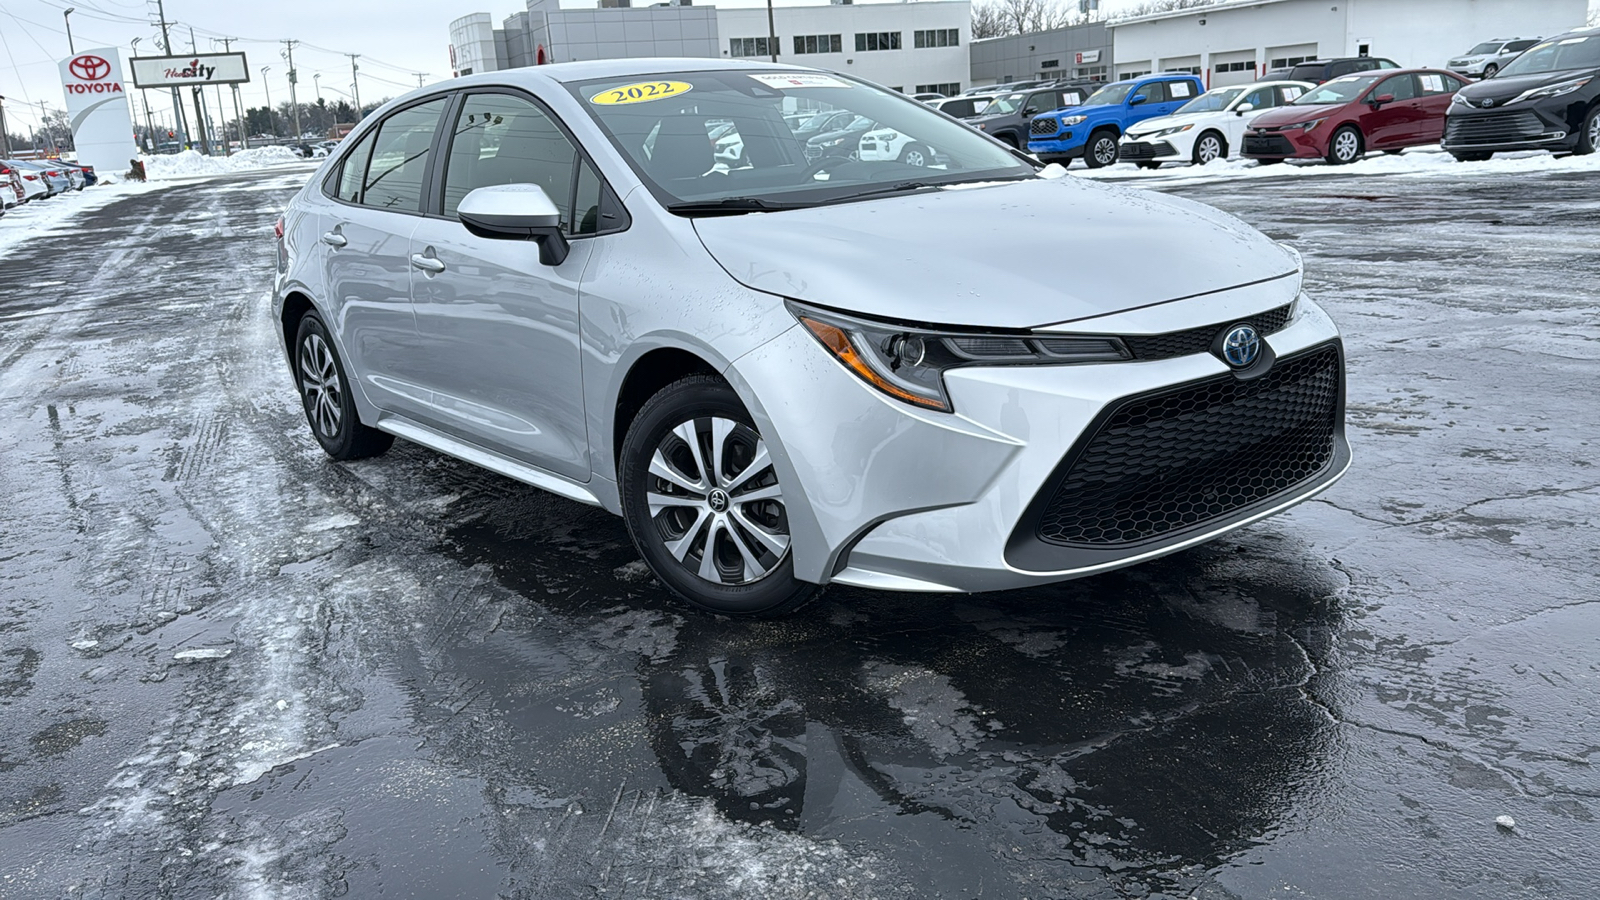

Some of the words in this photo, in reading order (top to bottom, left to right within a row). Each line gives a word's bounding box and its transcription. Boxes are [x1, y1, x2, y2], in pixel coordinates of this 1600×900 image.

[65, 82, 123, 94] TOYOTA
[610, 82, 675, 103] 2022
[624, 460, 640, 535] YOKOHAMA
